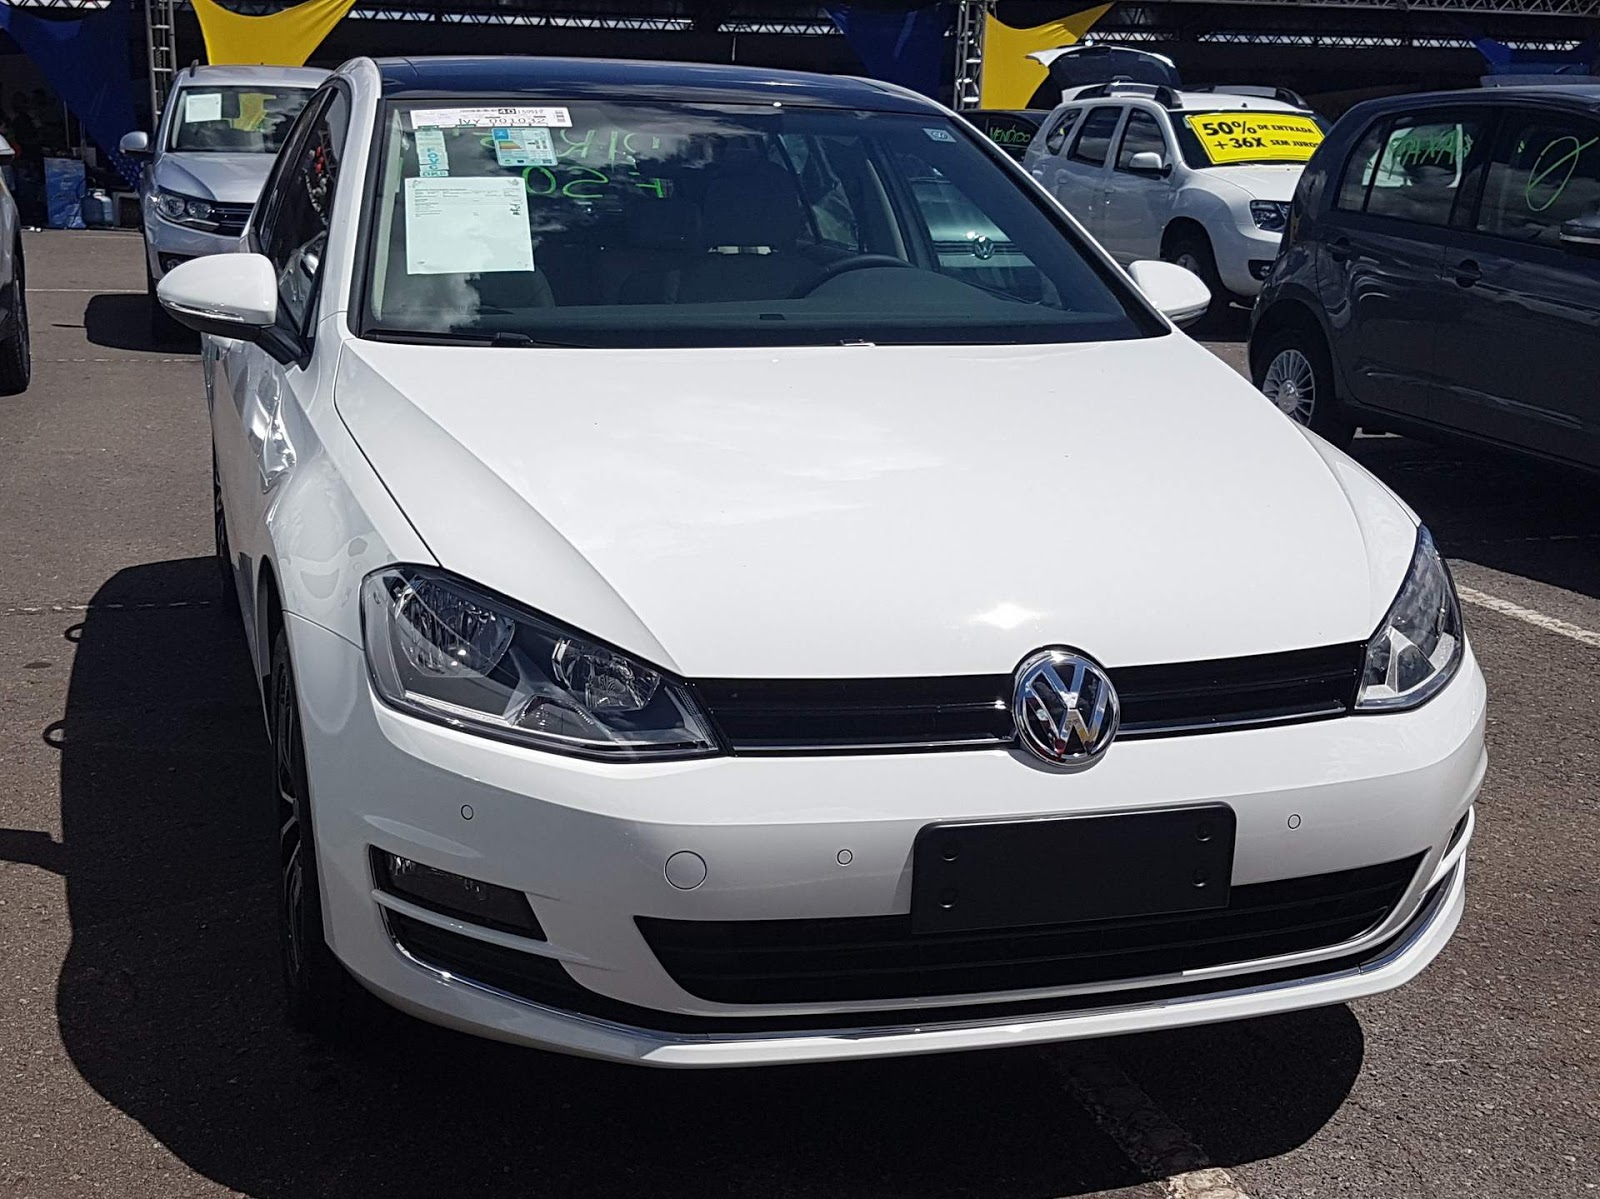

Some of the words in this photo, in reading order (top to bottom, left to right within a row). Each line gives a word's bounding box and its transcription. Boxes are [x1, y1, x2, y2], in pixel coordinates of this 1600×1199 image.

[1202, 121, 1257, 136] 50%
[1272, 124, 1315, 134] ENTRADA
[1270, 139, 1290, 147] SEM
